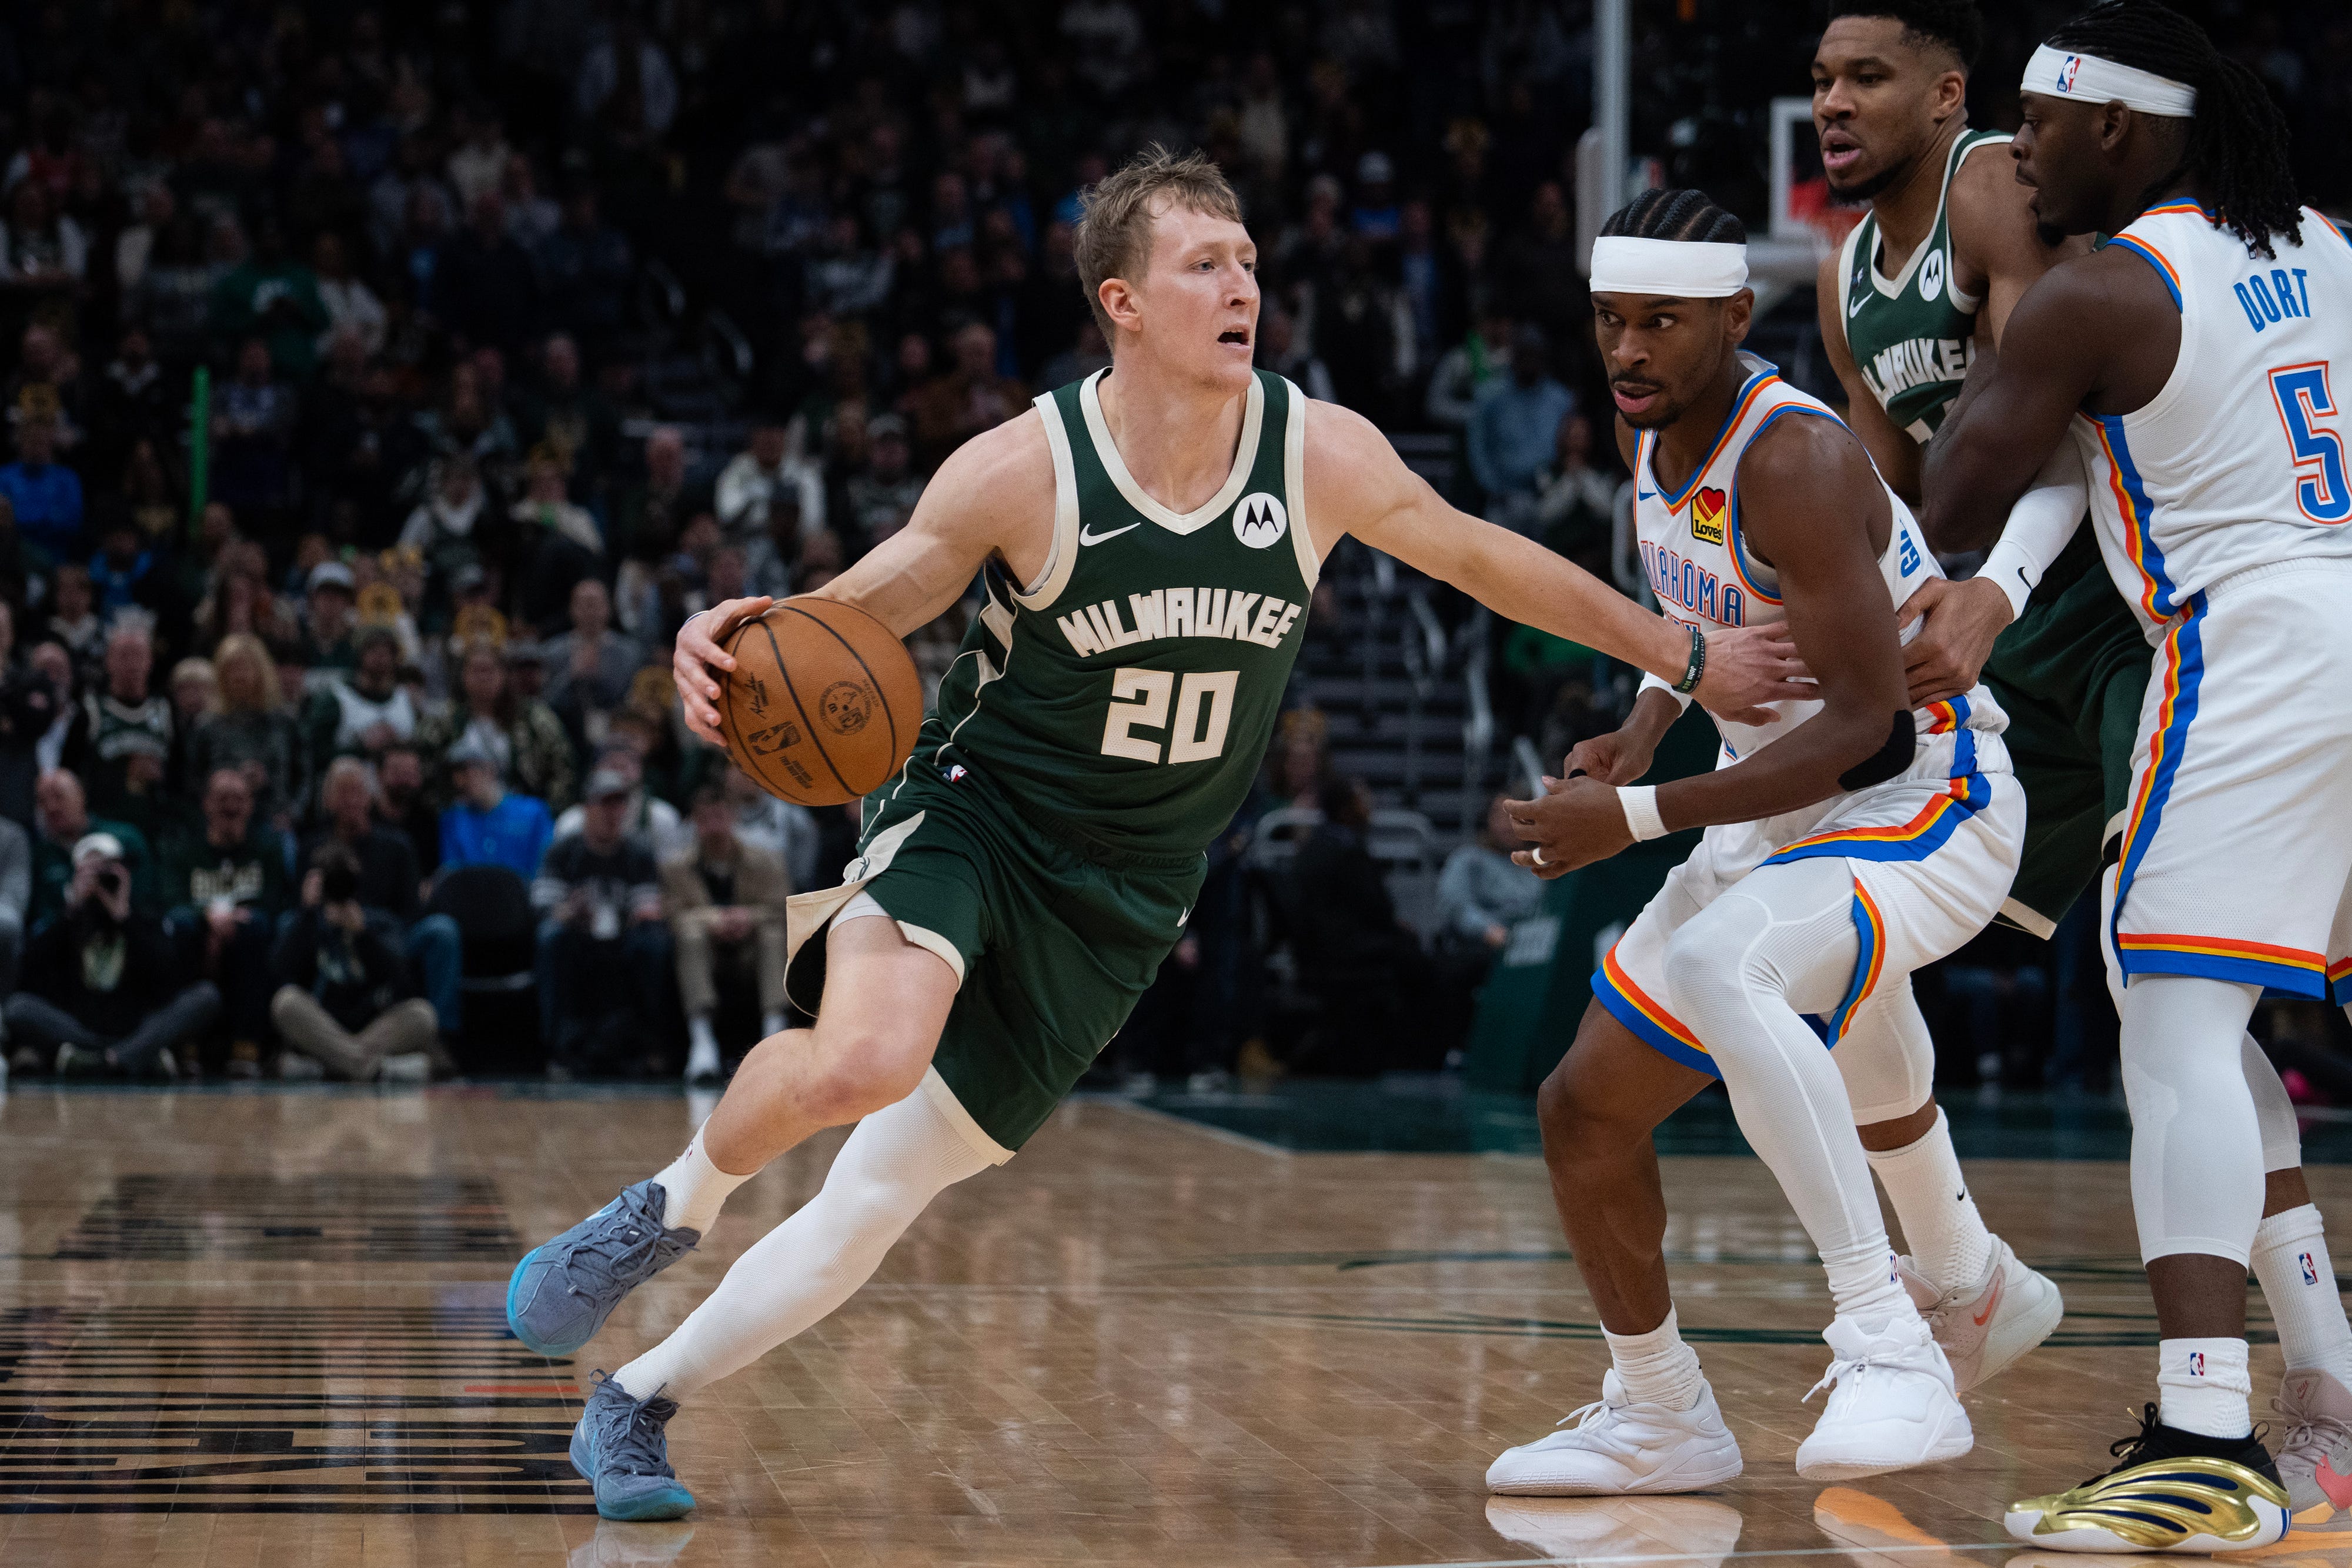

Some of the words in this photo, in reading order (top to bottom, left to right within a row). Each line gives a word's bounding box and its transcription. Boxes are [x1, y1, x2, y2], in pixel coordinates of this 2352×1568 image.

[2233, 268, 2310, 333] DORT
[2267, 360, 2352, 525] 5
[1694, 519, 1722, 540] Love's
[1057, 587, 1302, 657] MILWAUKEE
[1687, 666, 1697, 680] John
[1101, 667, 1240, 764] 20
